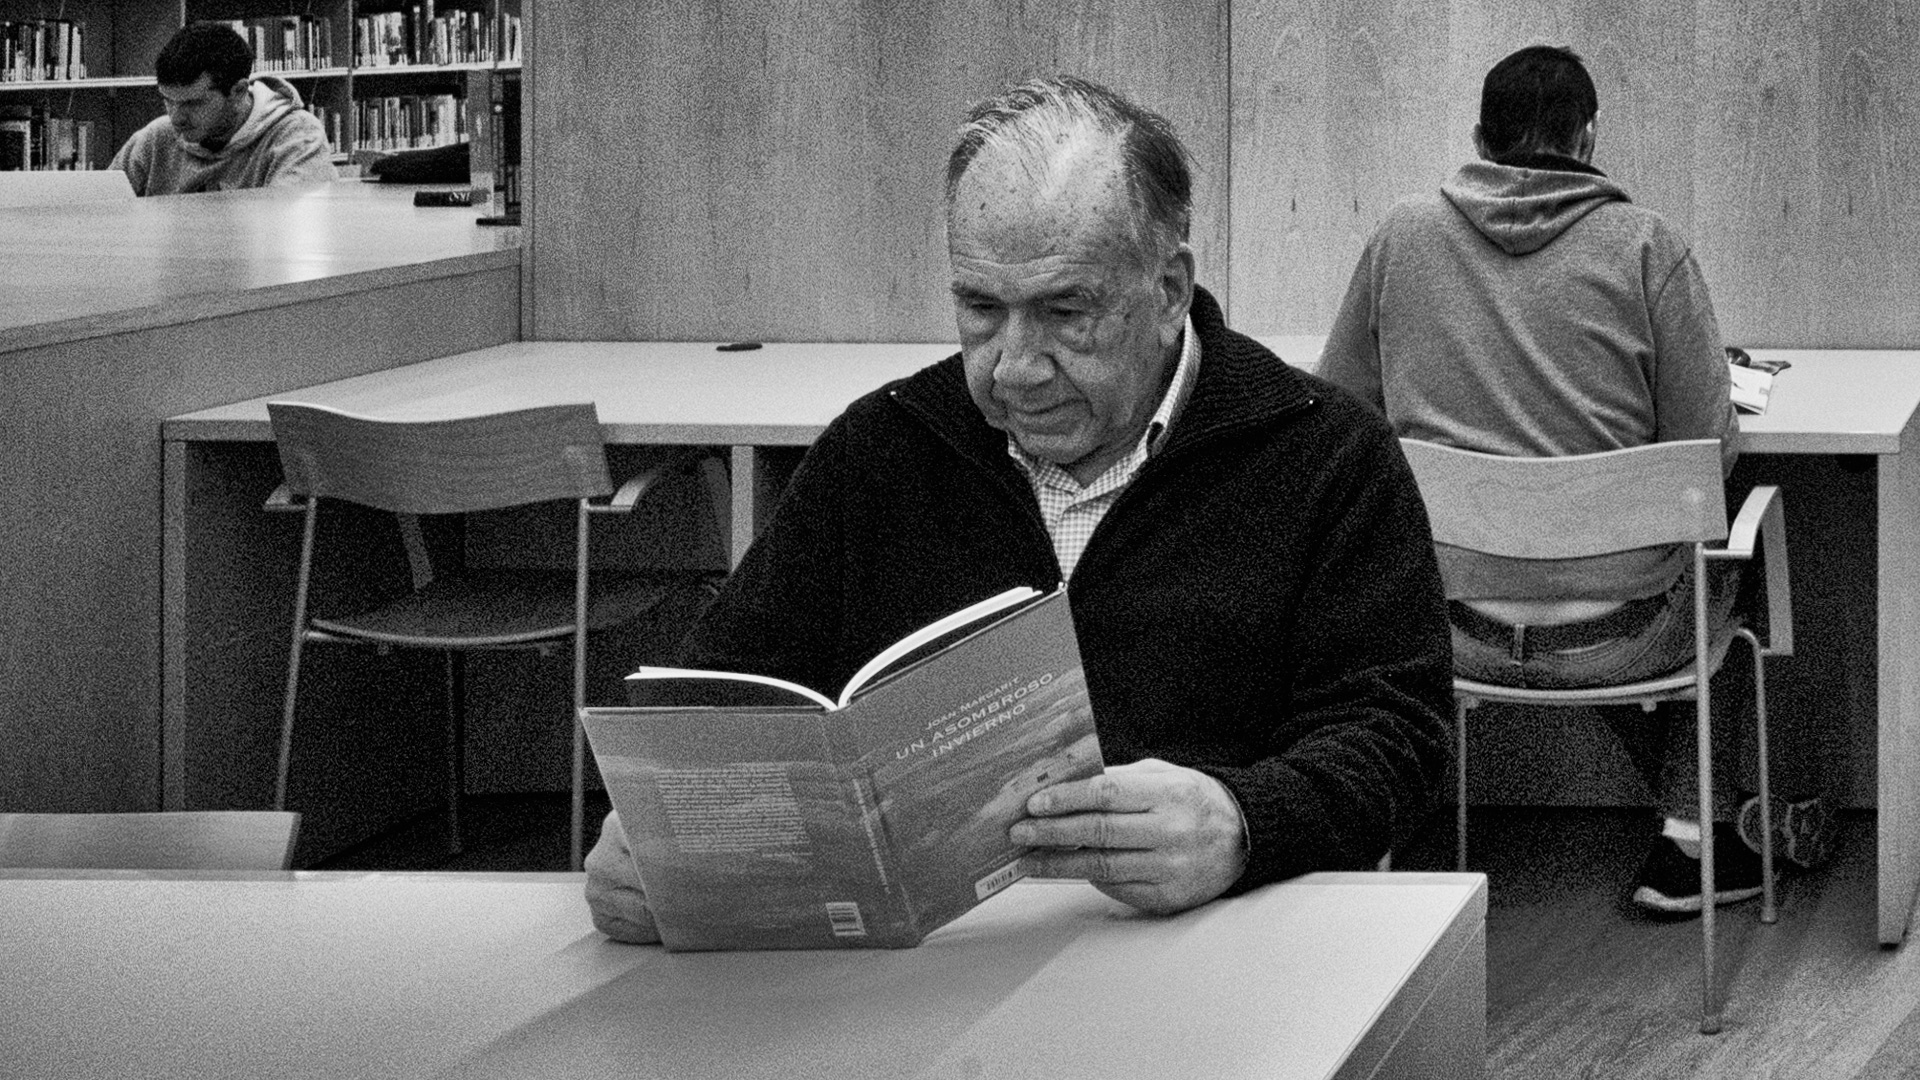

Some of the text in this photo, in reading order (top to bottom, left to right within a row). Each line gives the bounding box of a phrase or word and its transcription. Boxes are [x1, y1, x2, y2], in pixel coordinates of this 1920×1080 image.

[896, 673, 1053, 760] UN ASOMBROSO
[925, 676, 1019, 731] JOAN MARGARIT
[932, 703, 1026, 758] INVIERNO
